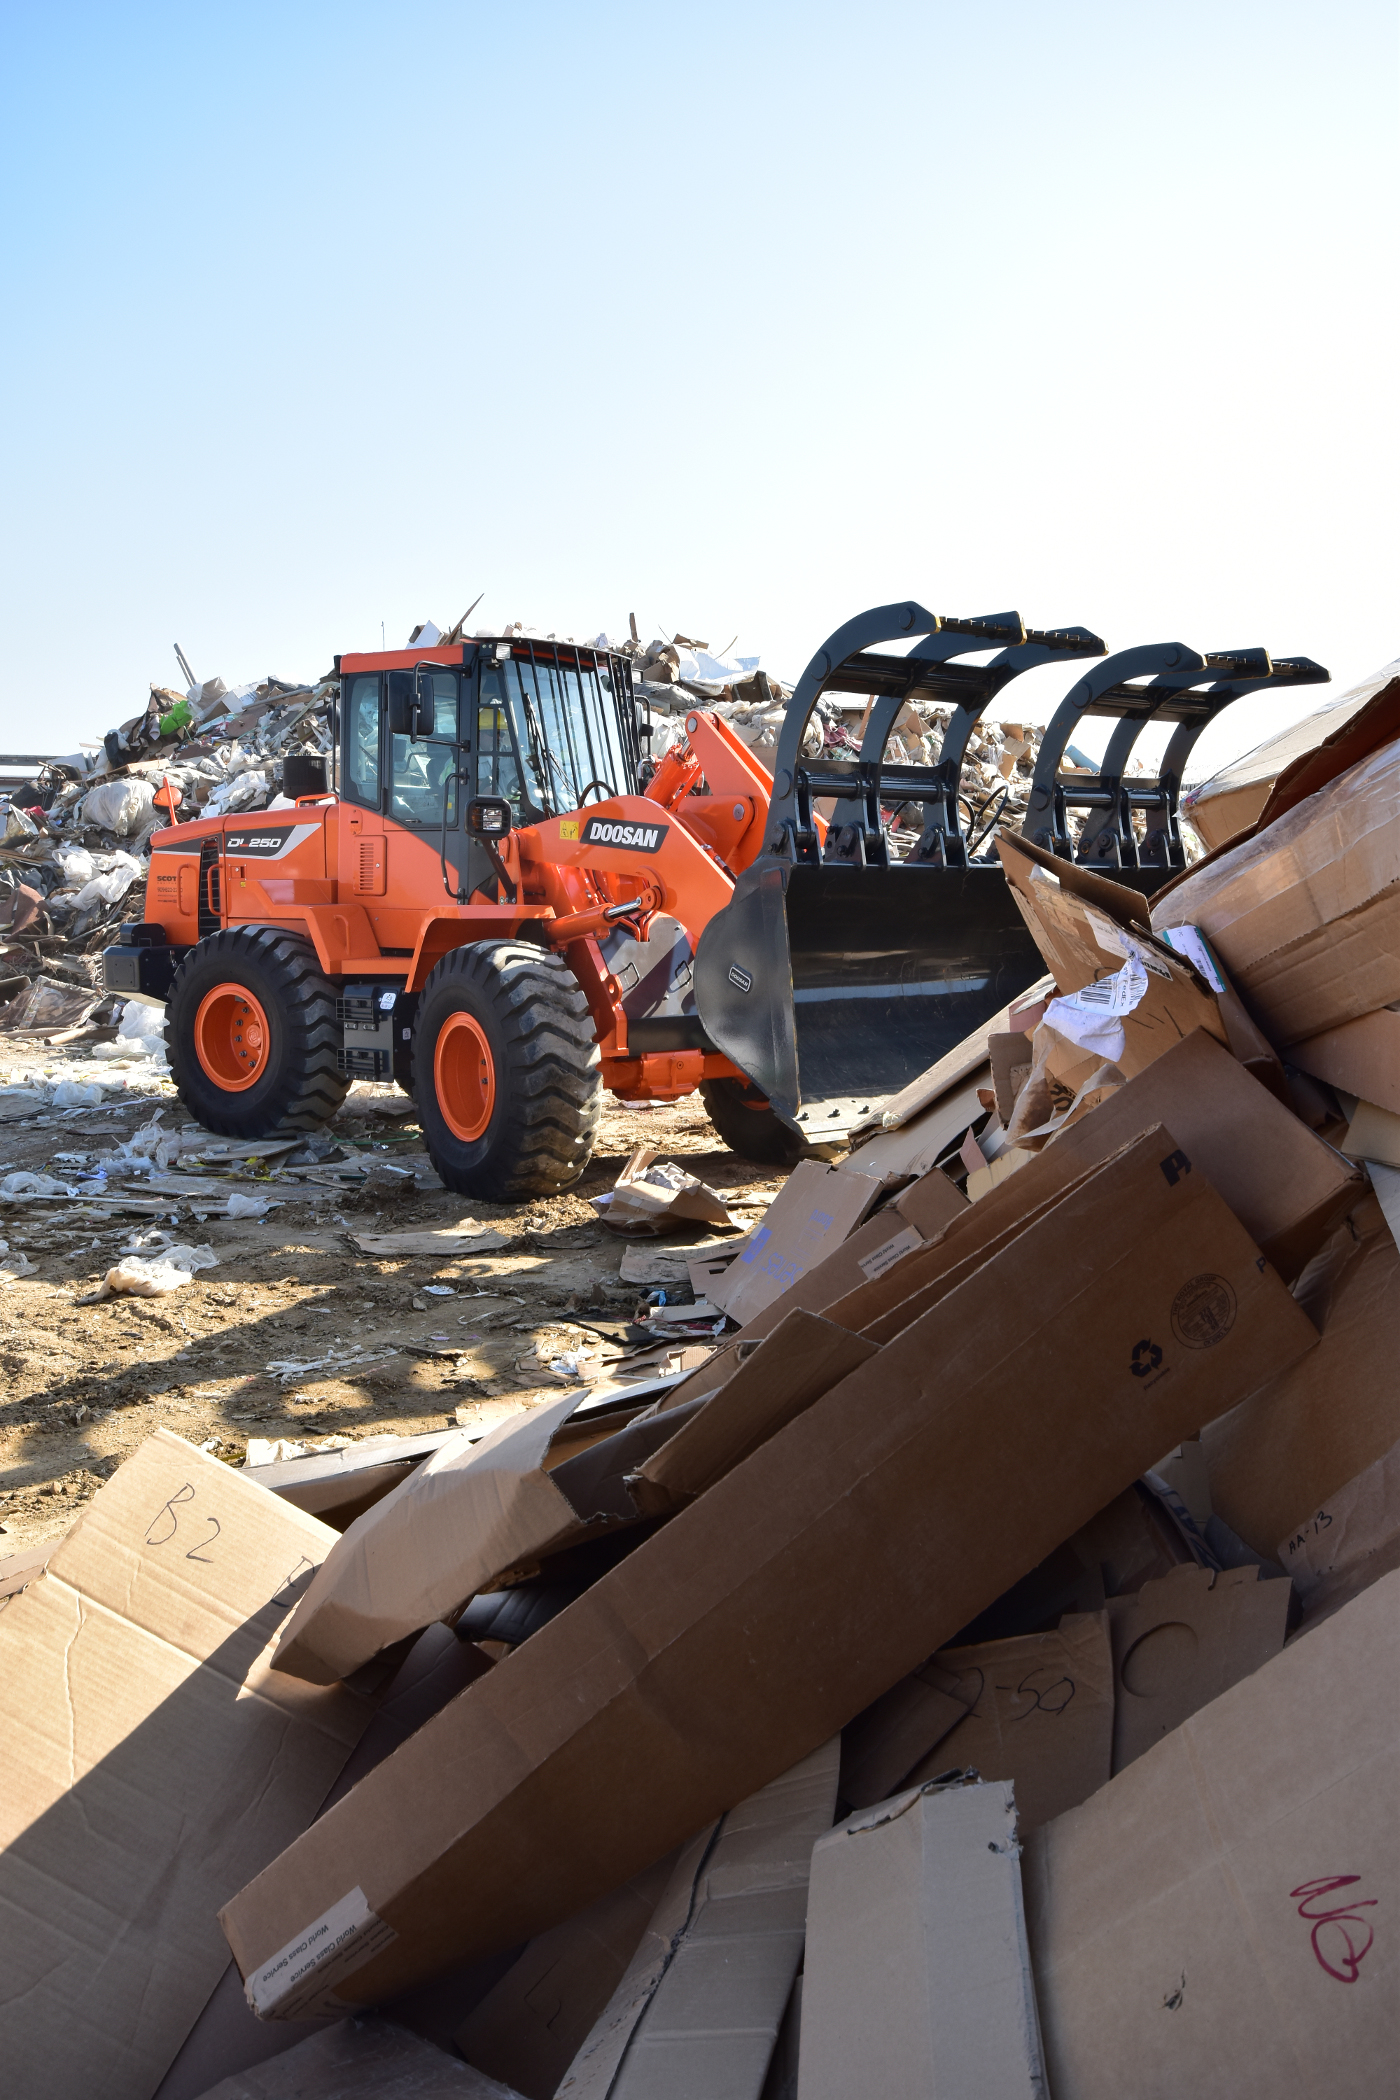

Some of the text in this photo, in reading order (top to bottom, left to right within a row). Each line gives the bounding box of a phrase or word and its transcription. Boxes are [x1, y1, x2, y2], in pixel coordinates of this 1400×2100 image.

[227, 838, 281, 848] DL250
[590, 822, 659, 848] DOOSAN
[1120, 979, 1128, 1007] FedEx
[809, 1209, 835, 1231] Board
[1177, 1282, 1195, 1302] ROYAL
[1194, 1275, 1217, 1284] GROUP
[1288, 1510, 1333, 1555] AA-13
[262, 1924, 329, 1983] World Class Service
[290, 1924, 357, 1983] World Class Service
